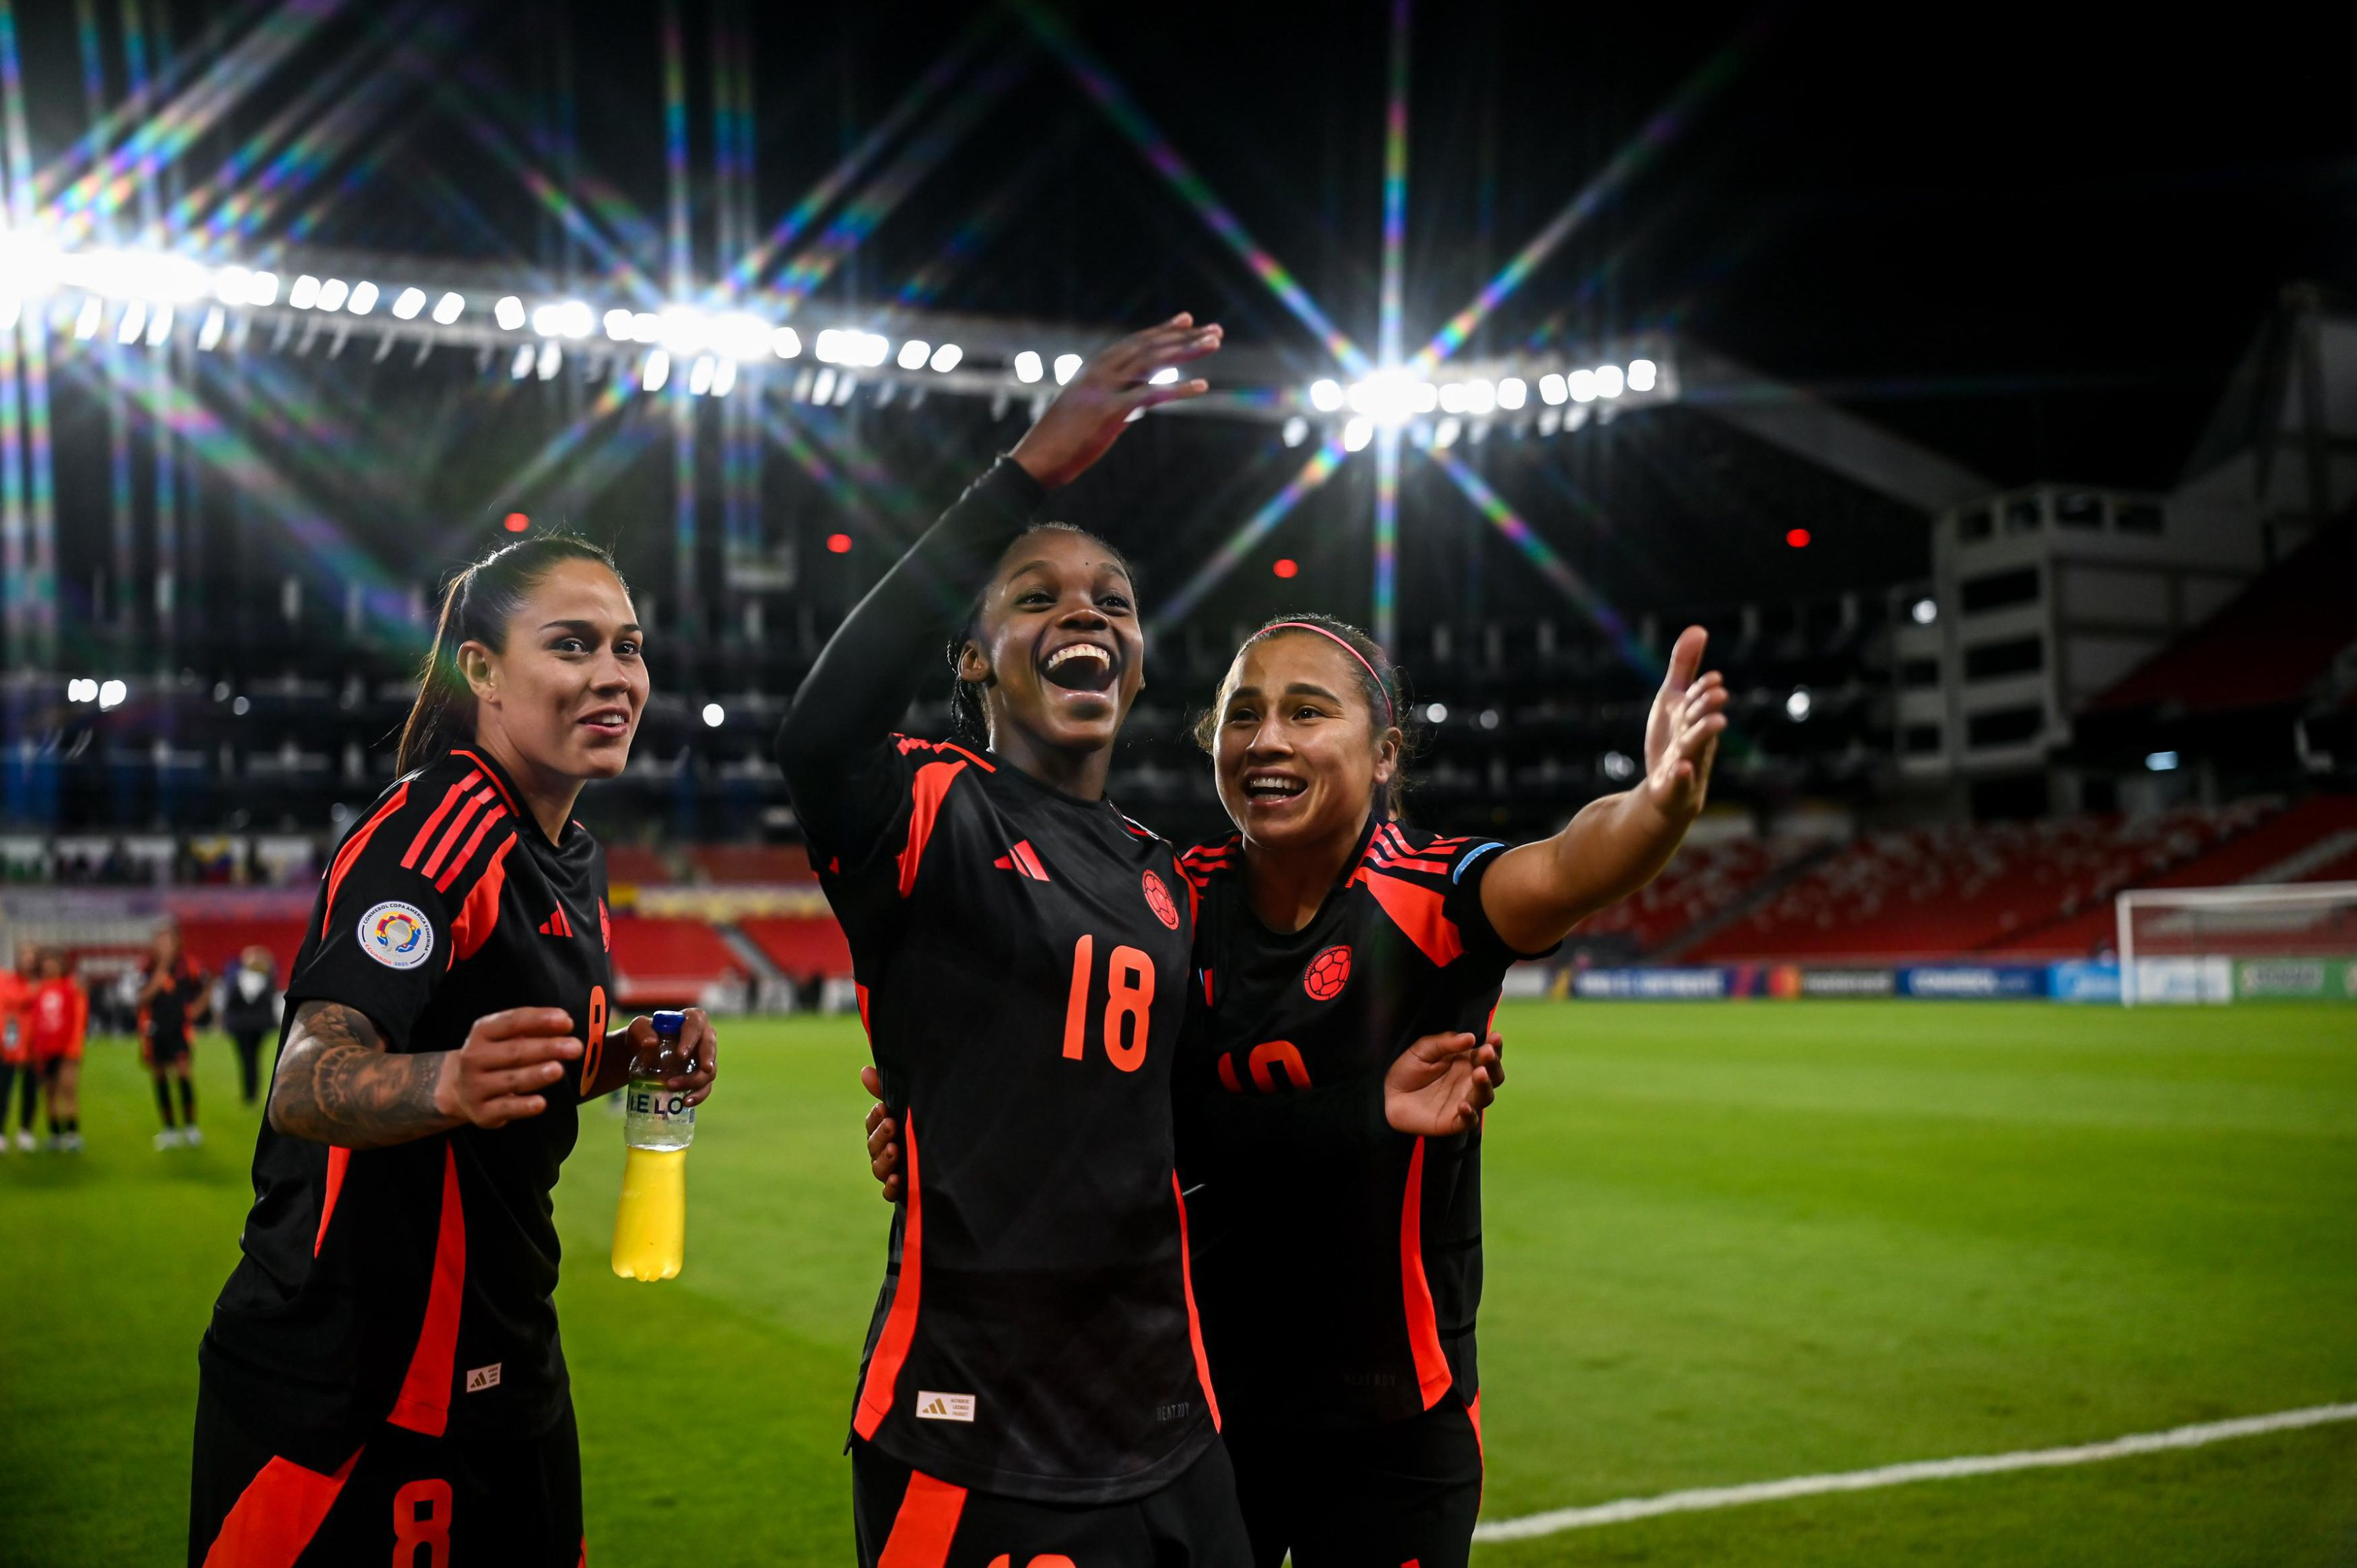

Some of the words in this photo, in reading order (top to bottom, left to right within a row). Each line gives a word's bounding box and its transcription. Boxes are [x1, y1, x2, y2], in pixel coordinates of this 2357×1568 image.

[363, 904, 390, 924] CONMEBOL
[405, 907, 427, 925] AMERICA
[365, 943, 392, 965] ECUADOR
[580, 985, 607, 1097] 8
[1062, 934, 1156, 1073] 18
[392, 1478, 453, 1568] 8
